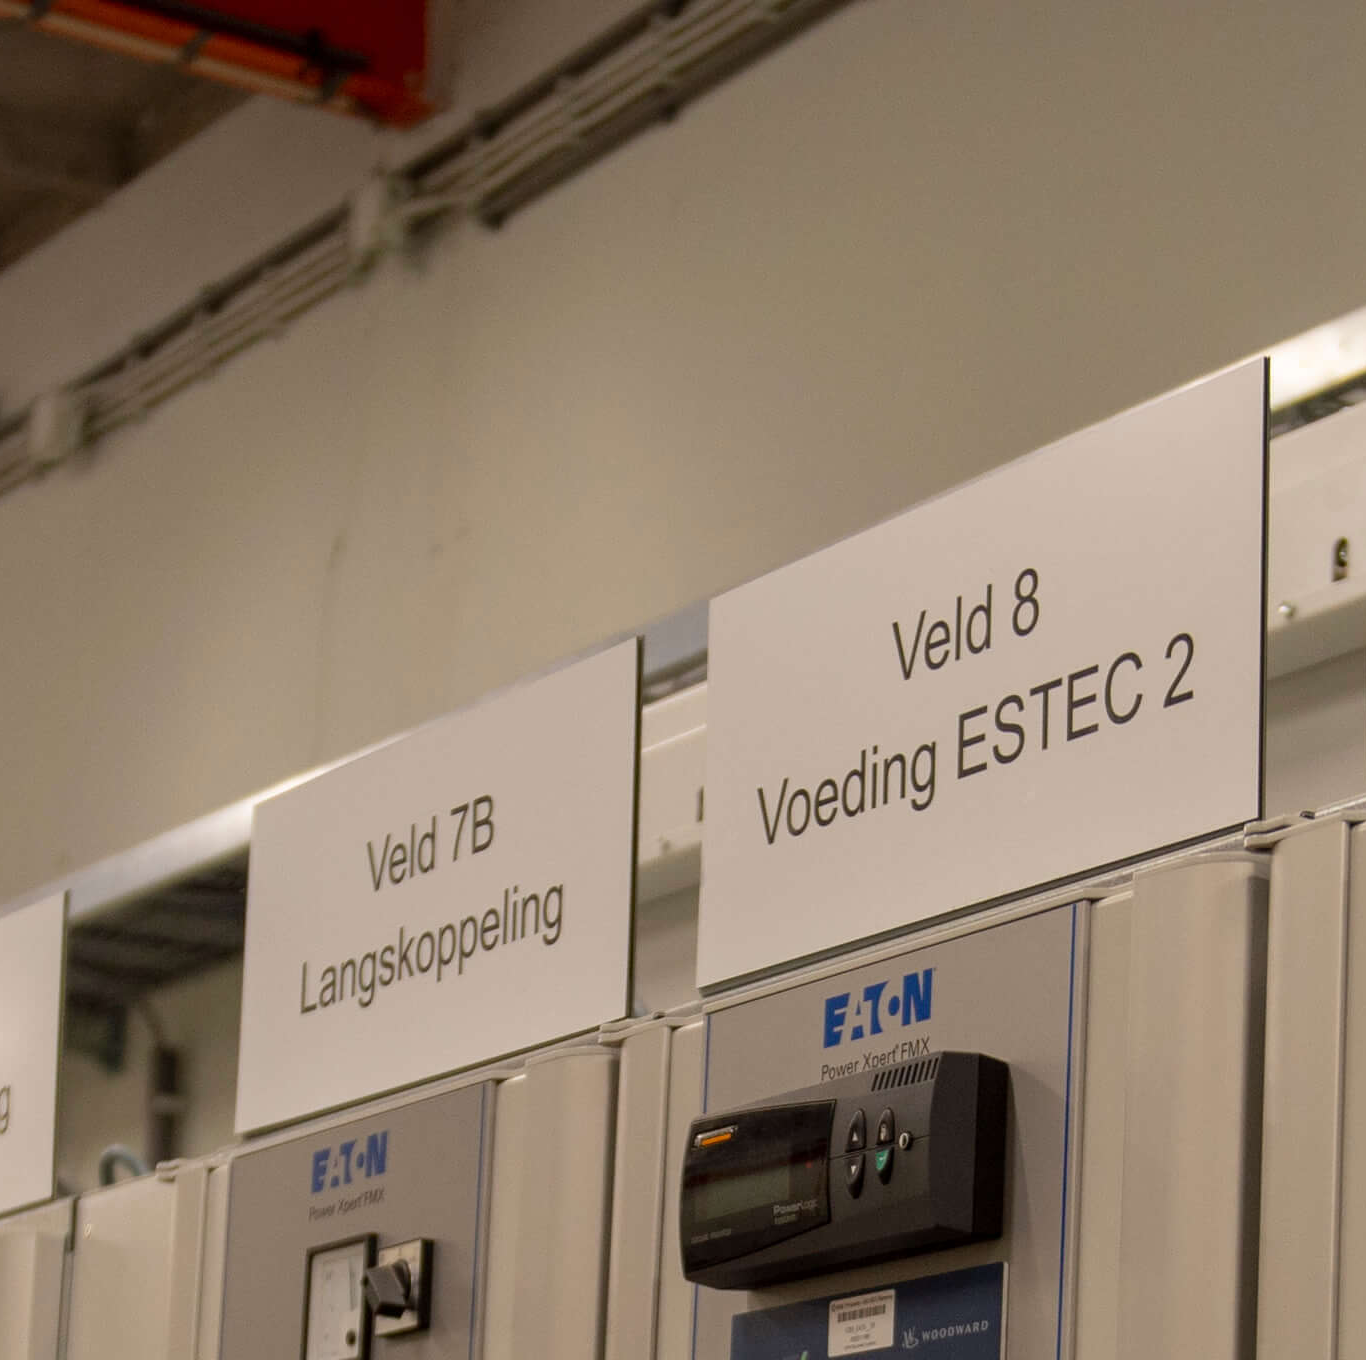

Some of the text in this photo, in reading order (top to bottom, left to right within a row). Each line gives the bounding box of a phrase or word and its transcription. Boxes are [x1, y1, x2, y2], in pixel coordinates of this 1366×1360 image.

[892, 567, 1040, 680] Veld 8
[758, 633, 1195, 845] Voeding ESTEC 2
[367, 794, 495, 892] Veld 7B
[300, 884, 564, 1015] Langskoppeling
[823, 967, 934, 1049] EATON
[821, 1060, 860, 1081] Power
[901, 1036, 930, 1060] FMX
[922, 1320, 989, 1341] WOODWARD
